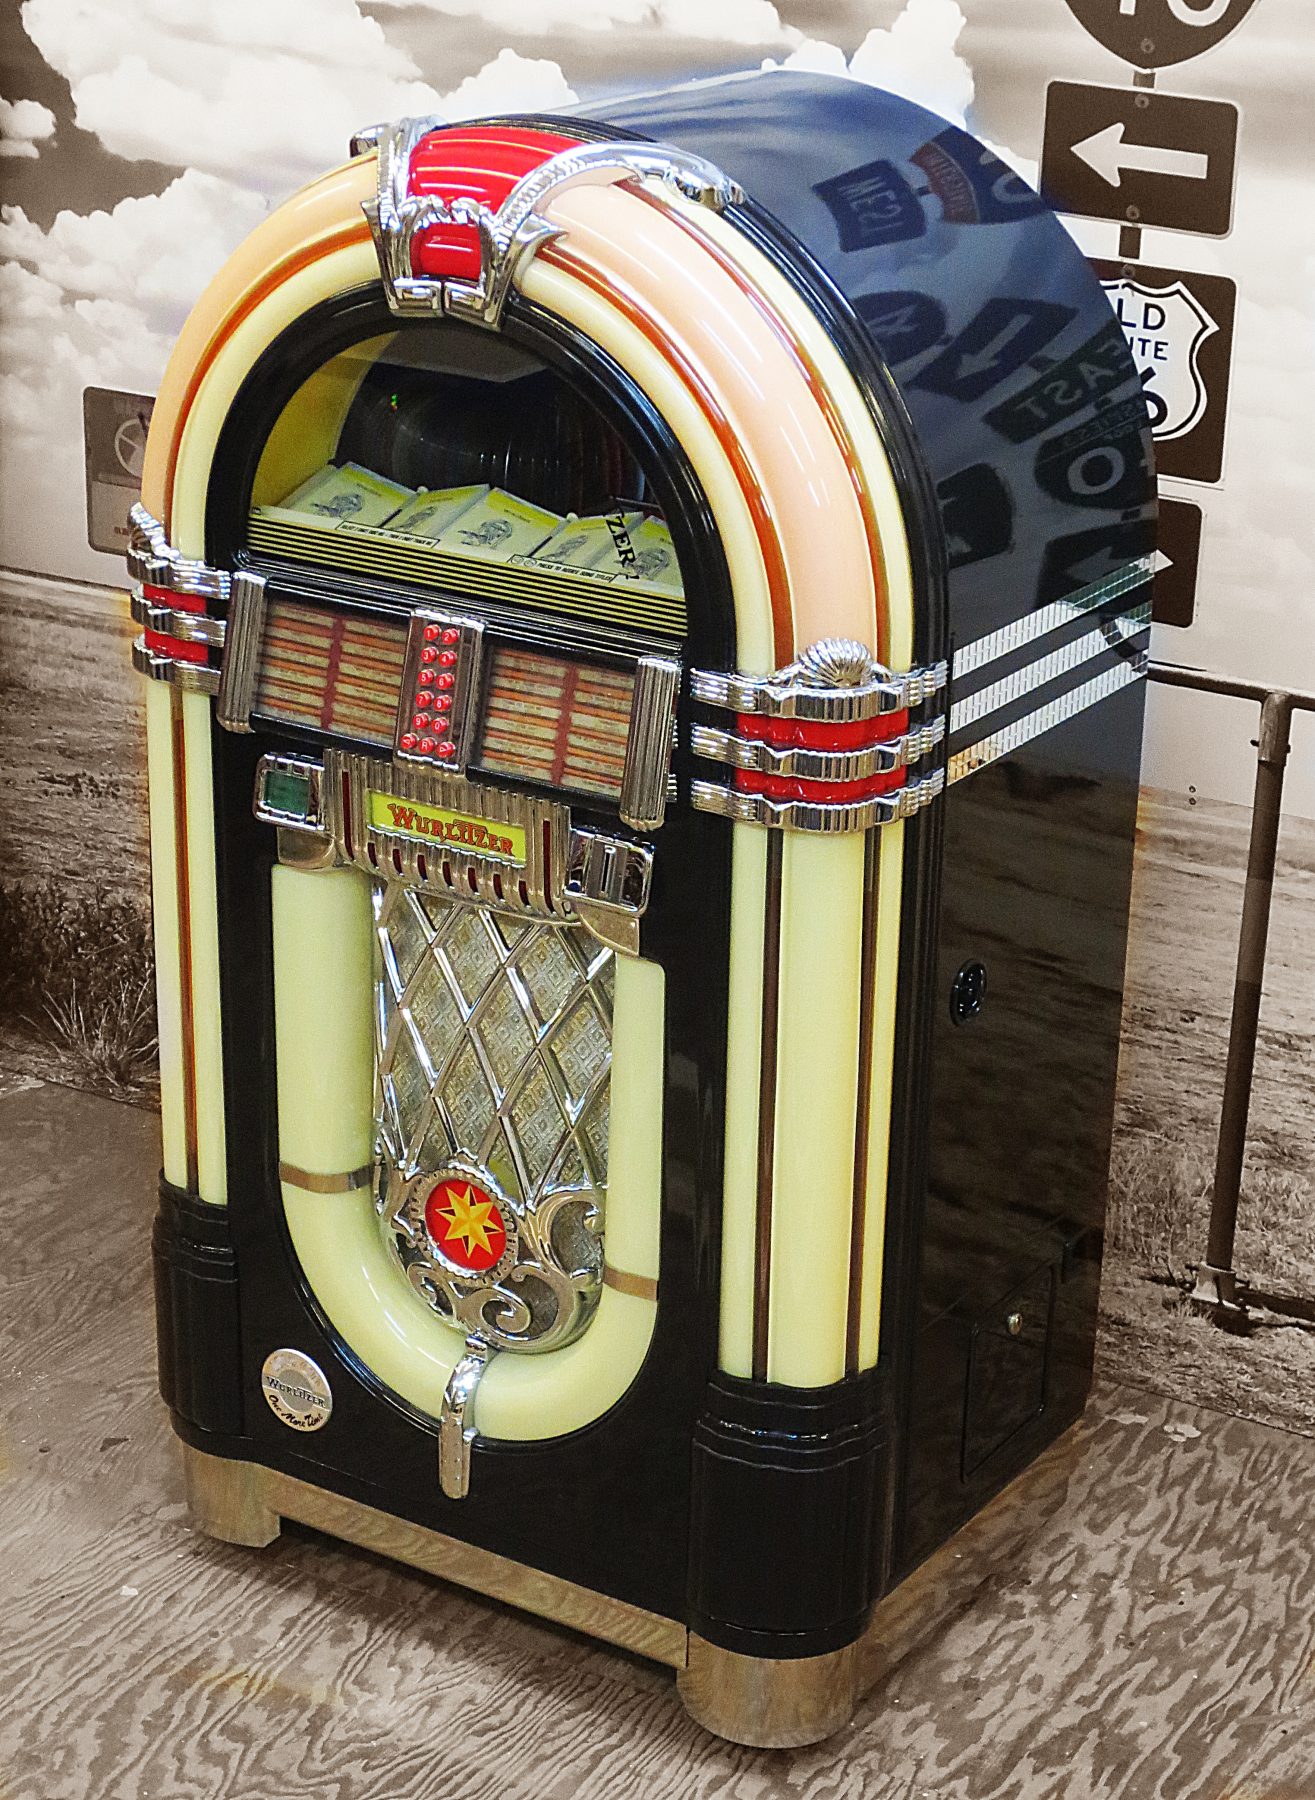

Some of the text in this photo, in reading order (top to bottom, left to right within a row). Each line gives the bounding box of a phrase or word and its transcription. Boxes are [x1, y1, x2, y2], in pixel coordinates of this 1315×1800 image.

[1116, 297, 1166, 331] LD
[1129, 336, 1169, 361] TE
[605, 516, 637, 568] ZER
[386, 802, 516, 857] WURLITZER
